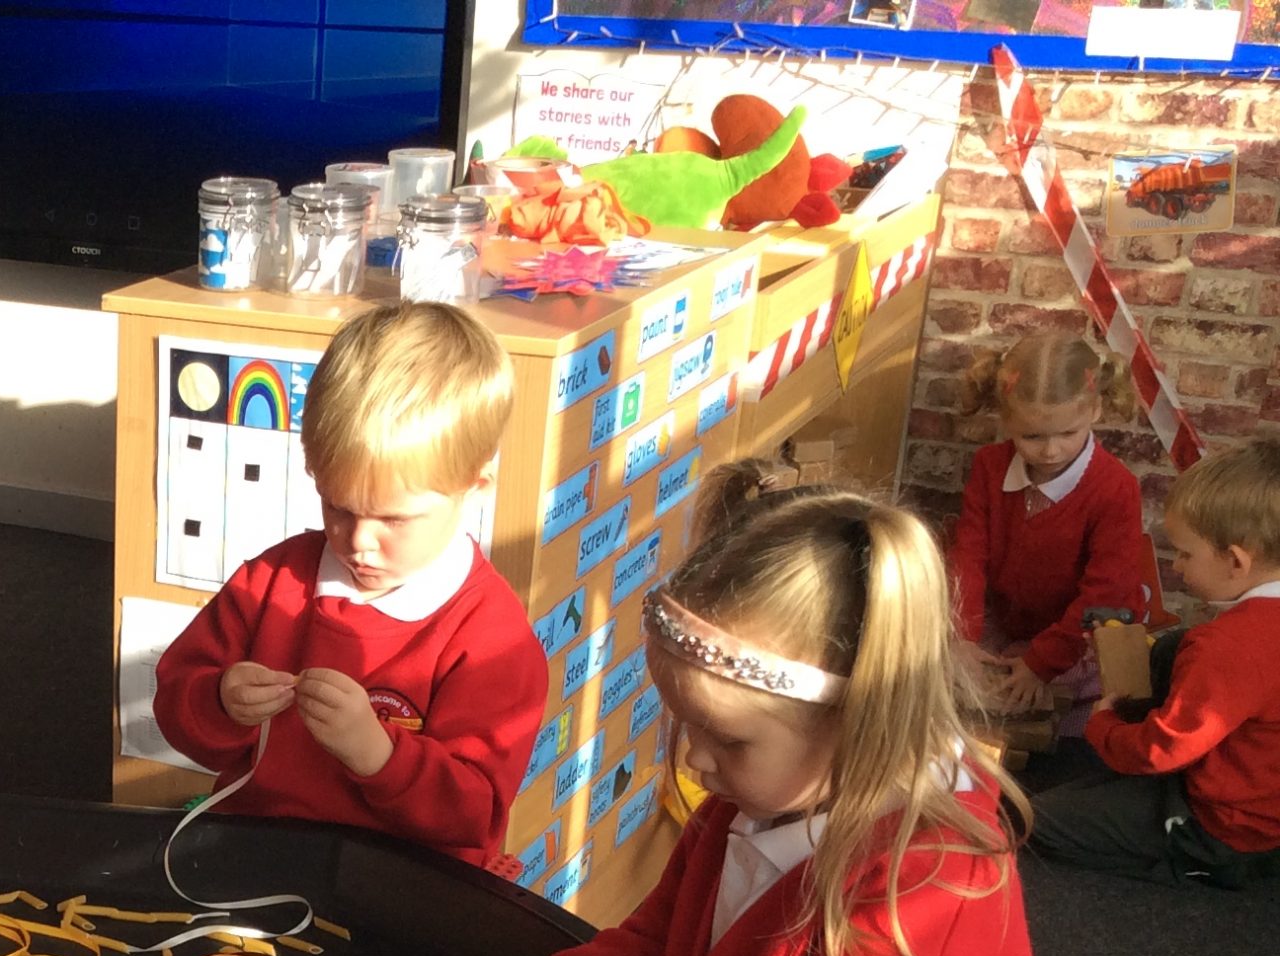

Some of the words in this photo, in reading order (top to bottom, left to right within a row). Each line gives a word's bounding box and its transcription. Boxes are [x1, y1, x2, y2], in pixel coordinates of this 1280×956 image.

[540, 81, 558, 97] We
[563, 82, 604, 100] share
[609, 89, 635, 102] our
[539, 108, 592, 125] stories
[598, 112, 631, 127] with
[640, 314, 668, 352] paint
[557, 359, 588, 398] brick
[625, 434, 657, 479] gloves
[565, 490, 583, 519] pipe
[657, 468, 689, 505] helmet
[579, 521, 612, 561] screw
[614, 553, 647, 590] concrete
[565, 645, 590, 688] steel
[370, 695, 401, 709] elcome
[401, 705, 411, 717] to
[601, 668, 634, 713] goggles
[555, 759, 588, 800] ladder
